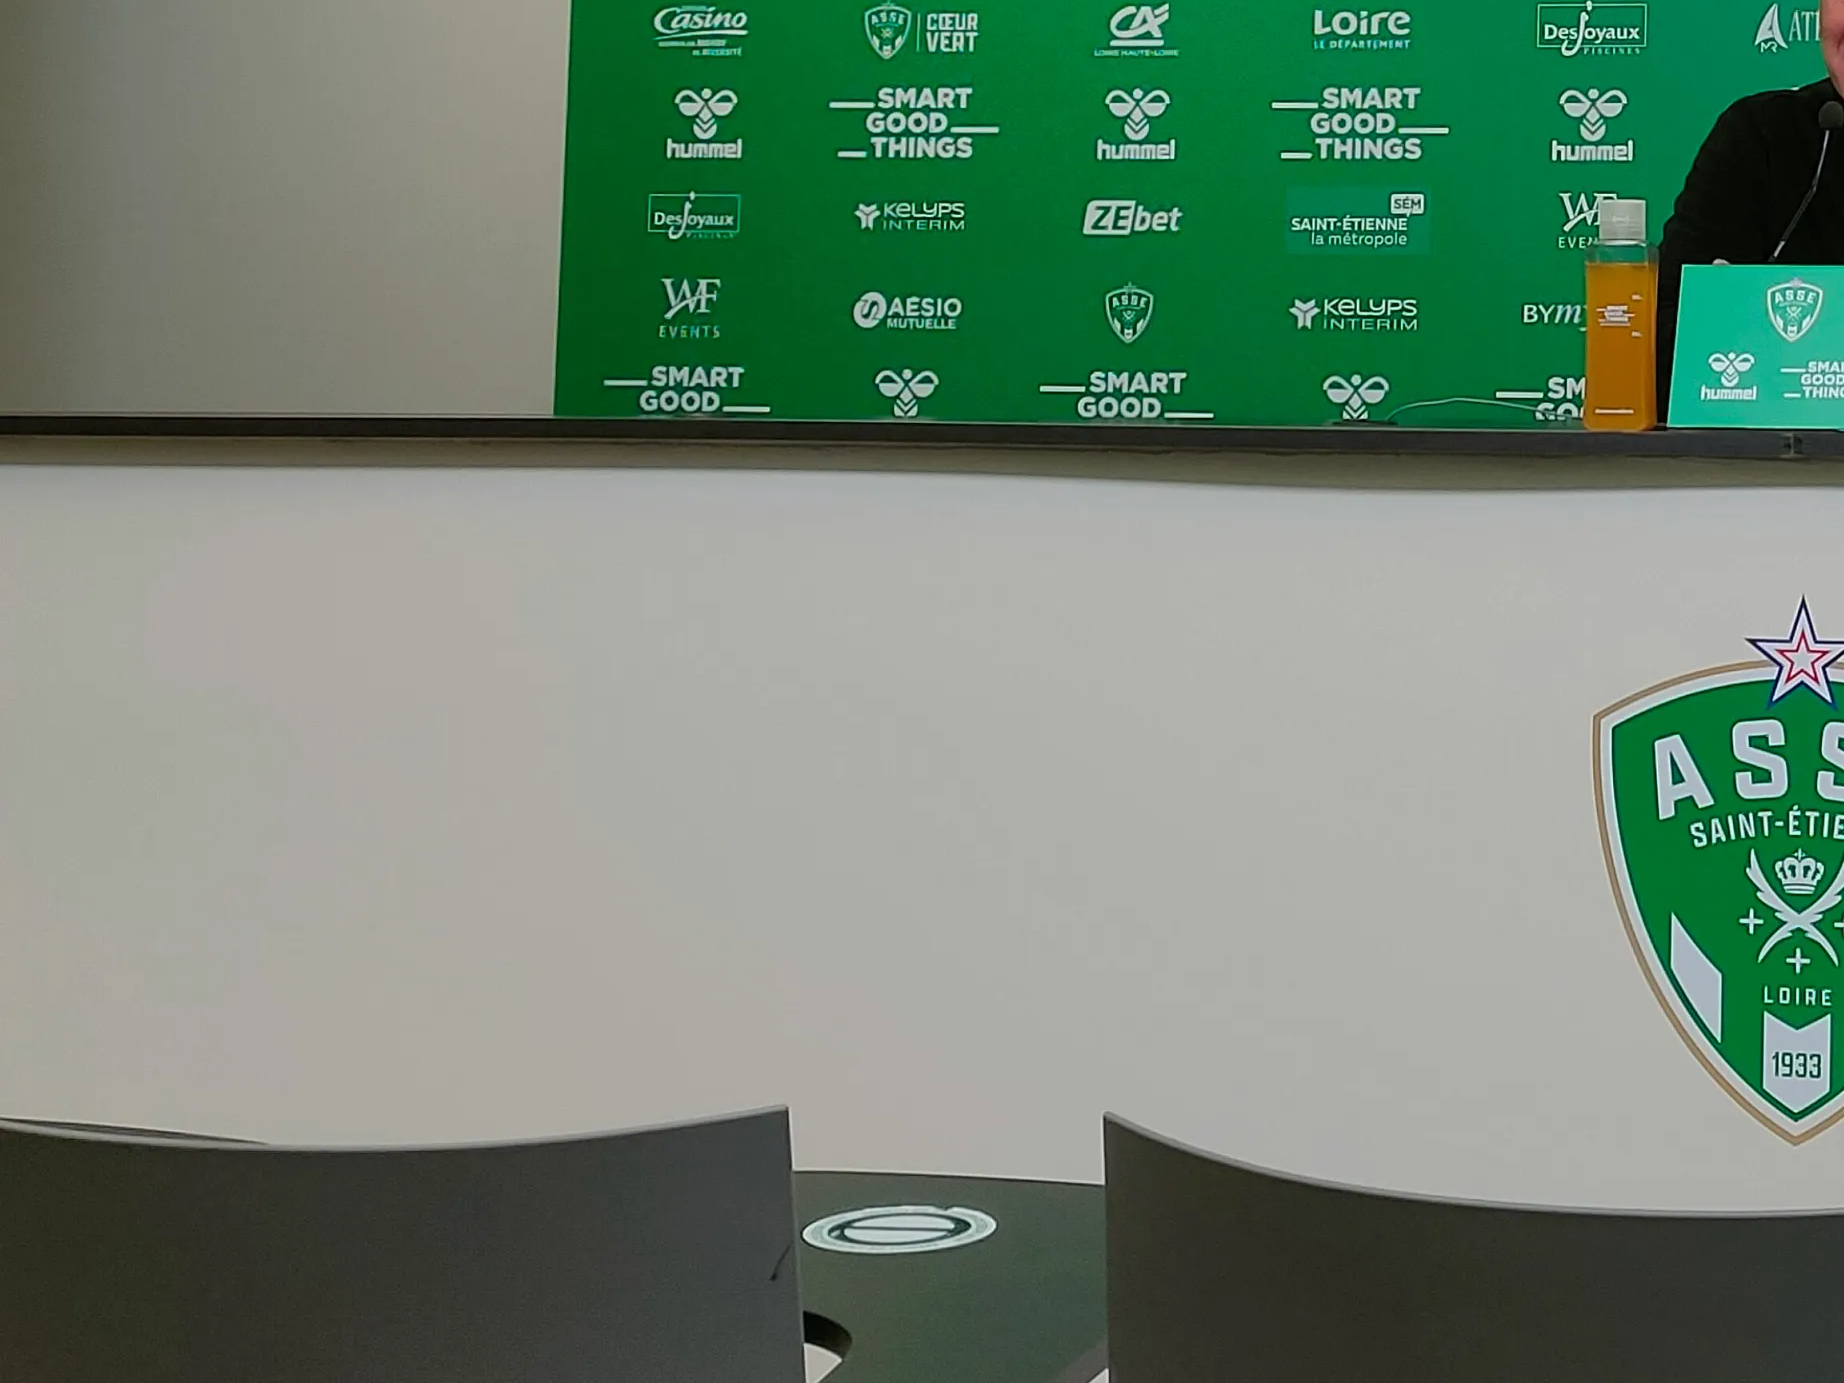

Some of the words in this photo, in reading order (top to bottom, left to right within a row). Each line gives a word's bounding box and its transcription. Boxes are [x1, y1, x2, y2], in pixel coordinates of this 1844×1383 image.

[654, 7, 747, 34] Casino
[1314, 10, 1410, 35] Loire
[926, 32, 978, 52] VERT
[878, 88, 972, 108] SMART
[1322, 87, 1420, 109] SMART
[866, 112, 948, 133] GOOD
[1311, 112, 1395, 134] GOOD
[667, 138, 742, 158] hummel
[871, 137, 972, 158] THINGS
[1097, 139, 1175, 160] hummel
[1315, 138, 1421, 159] THINGS
[1552, 140, 1633, 161] hummel
[884, 220, 964, 230] INTERIM
[1292, 215, 1407, 231] SAINT-ÉTIENNE
[1312, 232, 1324, 245] la
[1329, 232, 1407, 248] métropole
[1774, 288, 1815, 306] ASSE
[887, 318, 955, 329] MUTUELLE
[1324, 319, 1417, 330] INTERIM
[651, 366, 744, 387] SMART
[1090, 371, 1187, 394] SMART
[640, 390, 720, 412] GOOD
[1701, 385, 1757, 400] hummel
[1078, 396, 1161, 418] GOOD
[1763, 985, 1832, 1006] LOIRE
[1771, 1051, 1822, 1079] 1933
